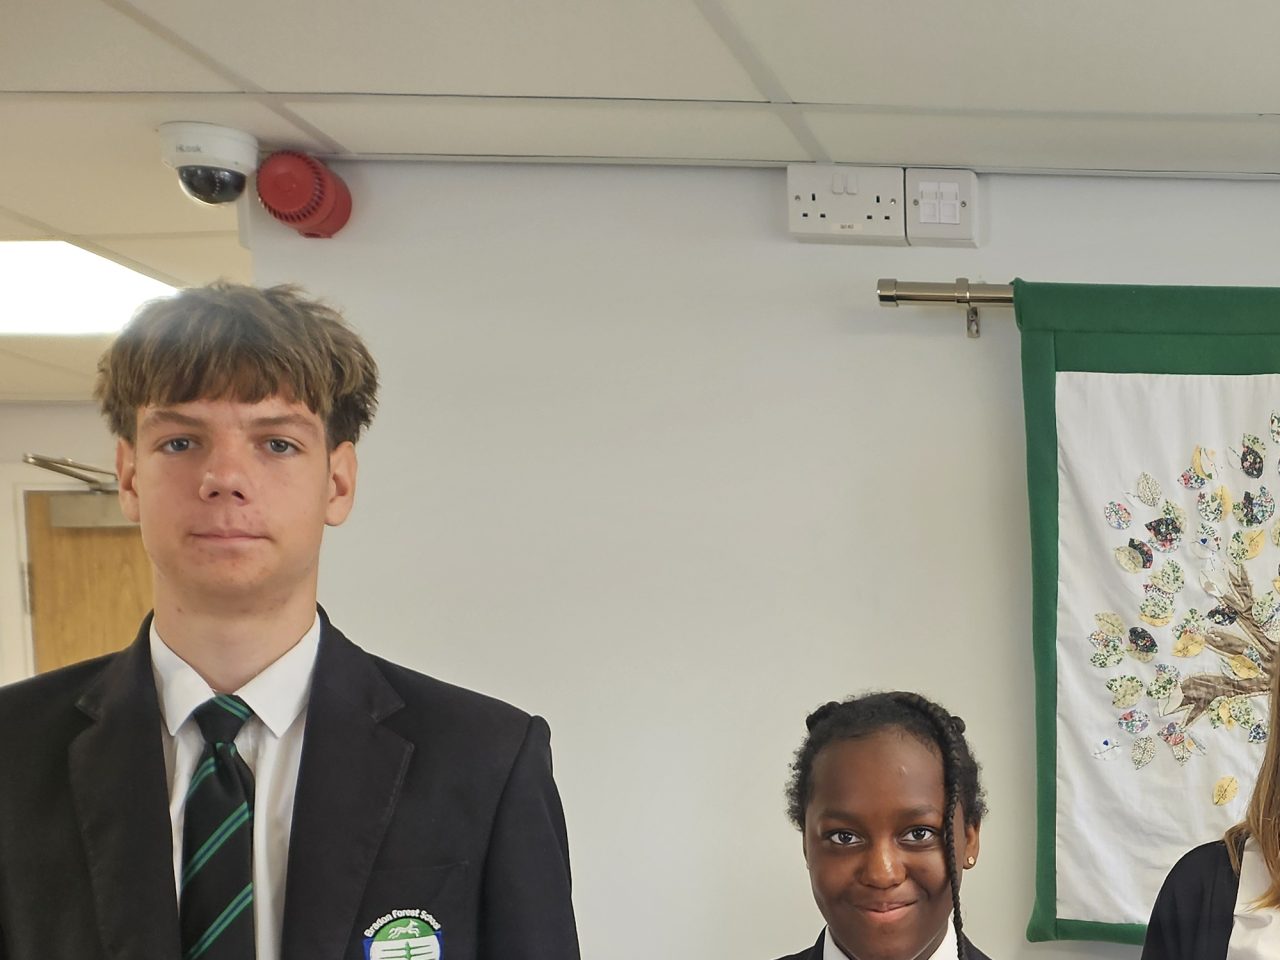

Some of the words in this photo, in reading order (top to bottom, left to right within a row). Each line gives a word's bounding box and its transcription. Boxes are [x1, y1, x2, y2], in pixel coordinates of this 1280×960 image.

[364, 913, 392, 938] Bradon
[391, 908, 421, 918] Forest
[420, 910, 442, 930] School
